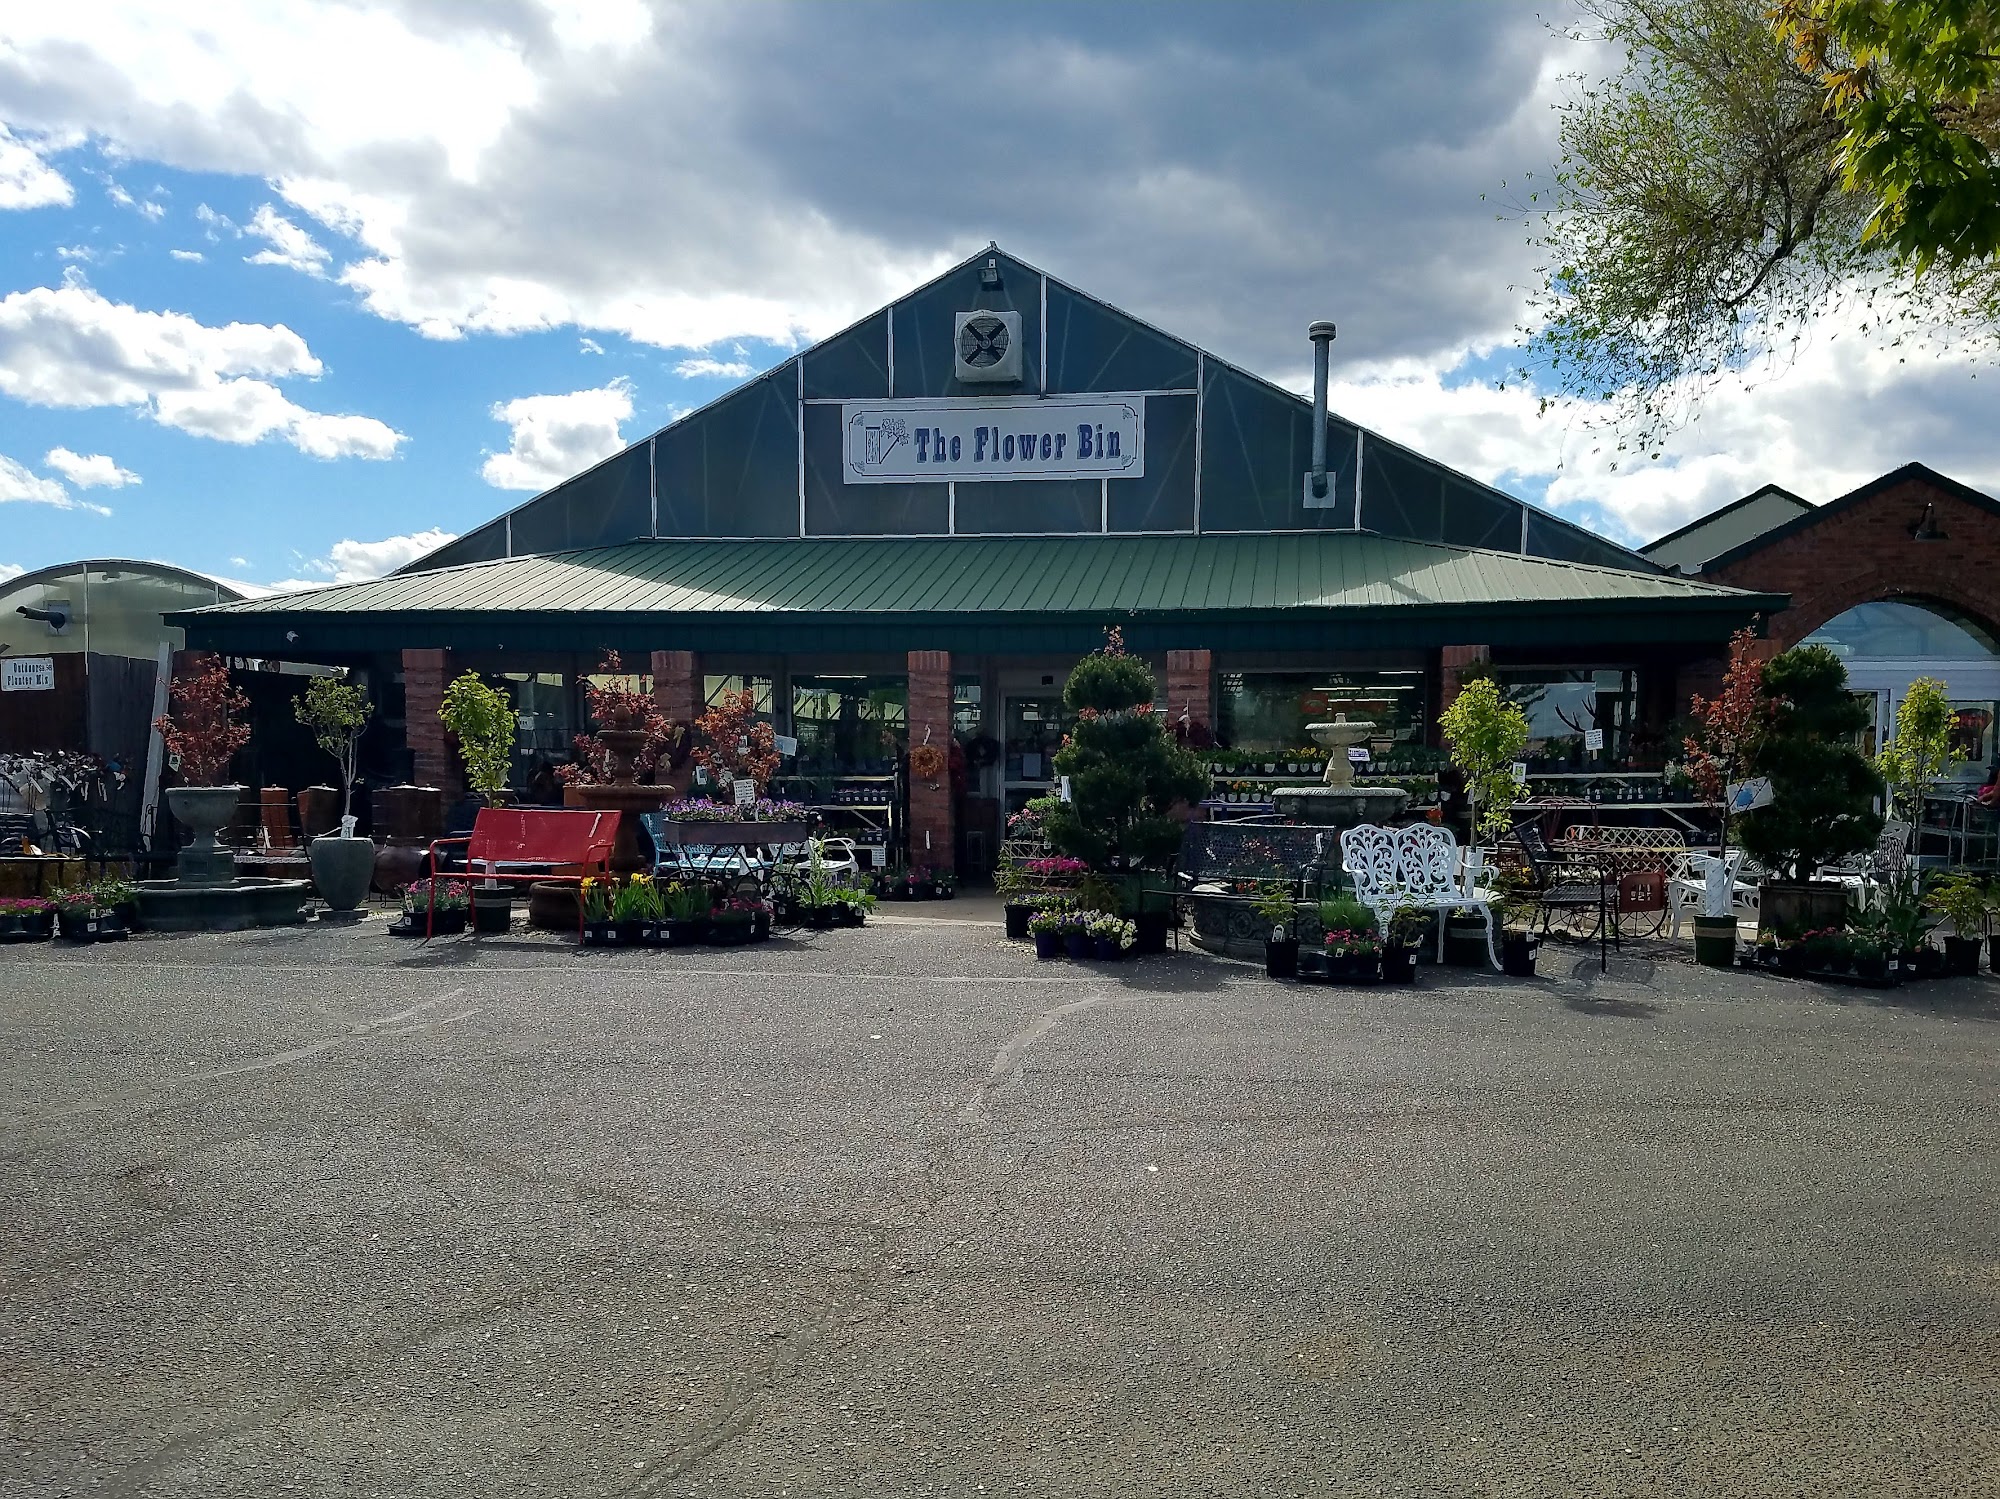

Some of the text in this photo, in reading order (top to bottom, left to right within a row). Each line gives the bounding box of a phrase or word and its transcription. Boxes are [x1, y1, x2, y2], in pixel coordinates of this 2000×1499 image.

[914, 423, 1121, 463] The Flower Bin
[7, 675, 33, 686] Planter
